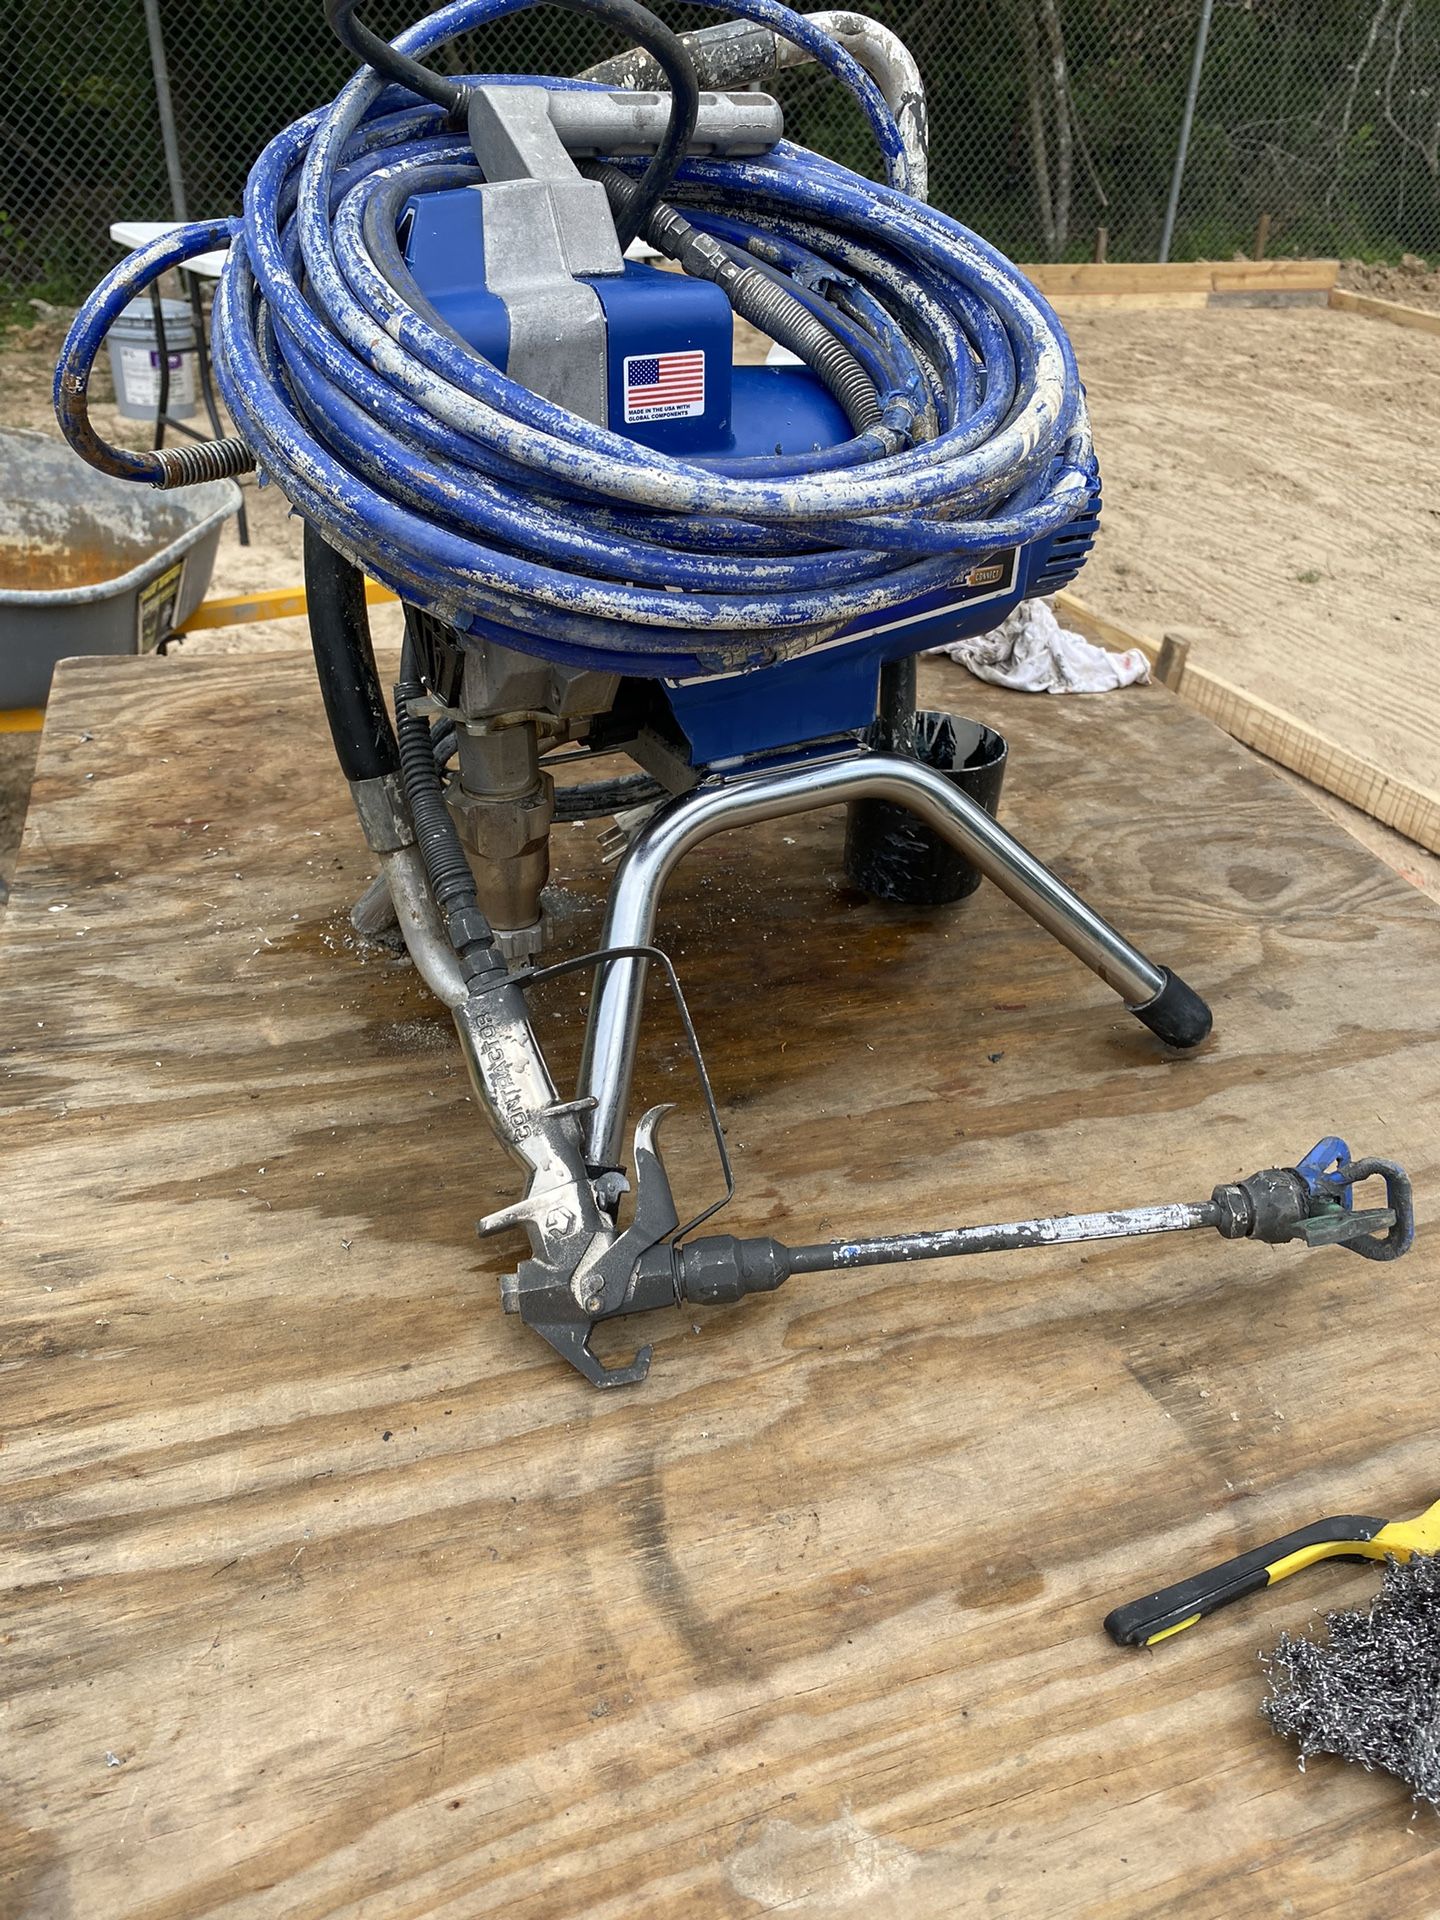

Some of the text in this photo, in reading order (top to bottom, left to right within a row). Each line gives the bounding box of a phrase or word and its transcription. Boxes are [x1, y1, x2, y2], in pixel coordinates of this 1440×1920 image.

[651, 410, 689, 419] COMPONENTS
[975, 569, 1000, 581] CONNECT
[475, 1011, 532, 1141] CONTRACTOR
